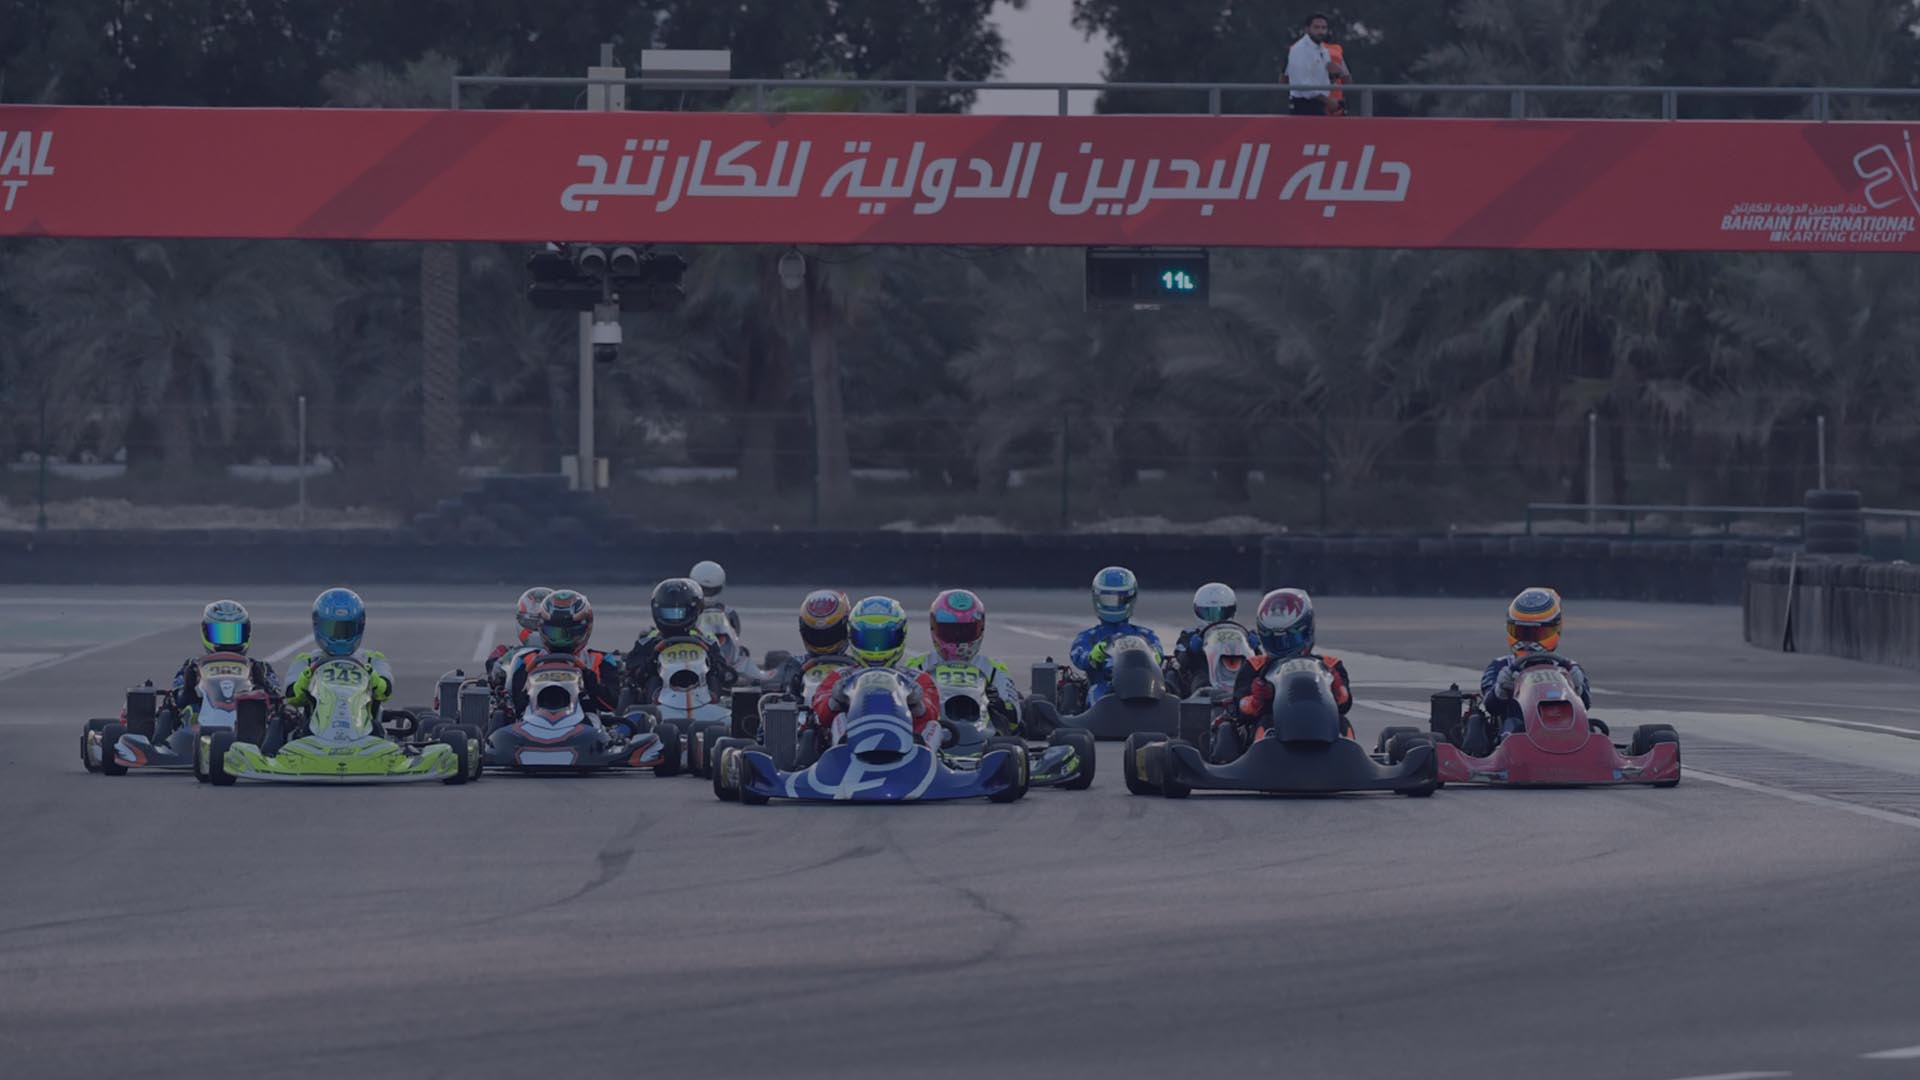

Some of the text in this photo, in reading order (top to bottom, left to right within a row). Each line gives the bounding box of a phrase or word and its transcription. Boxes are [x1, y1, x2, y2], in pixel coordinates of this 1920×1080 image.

[560, 139, 1411, 217] حلبة البحرين الدولية للكارتنج
[1721, 215, 1915, 231] BAHRAIN INTERNATIONAL
[1781, 231, 1907, 242] KARTING CIRCUIT
[322, 668, 362, 684] 343
